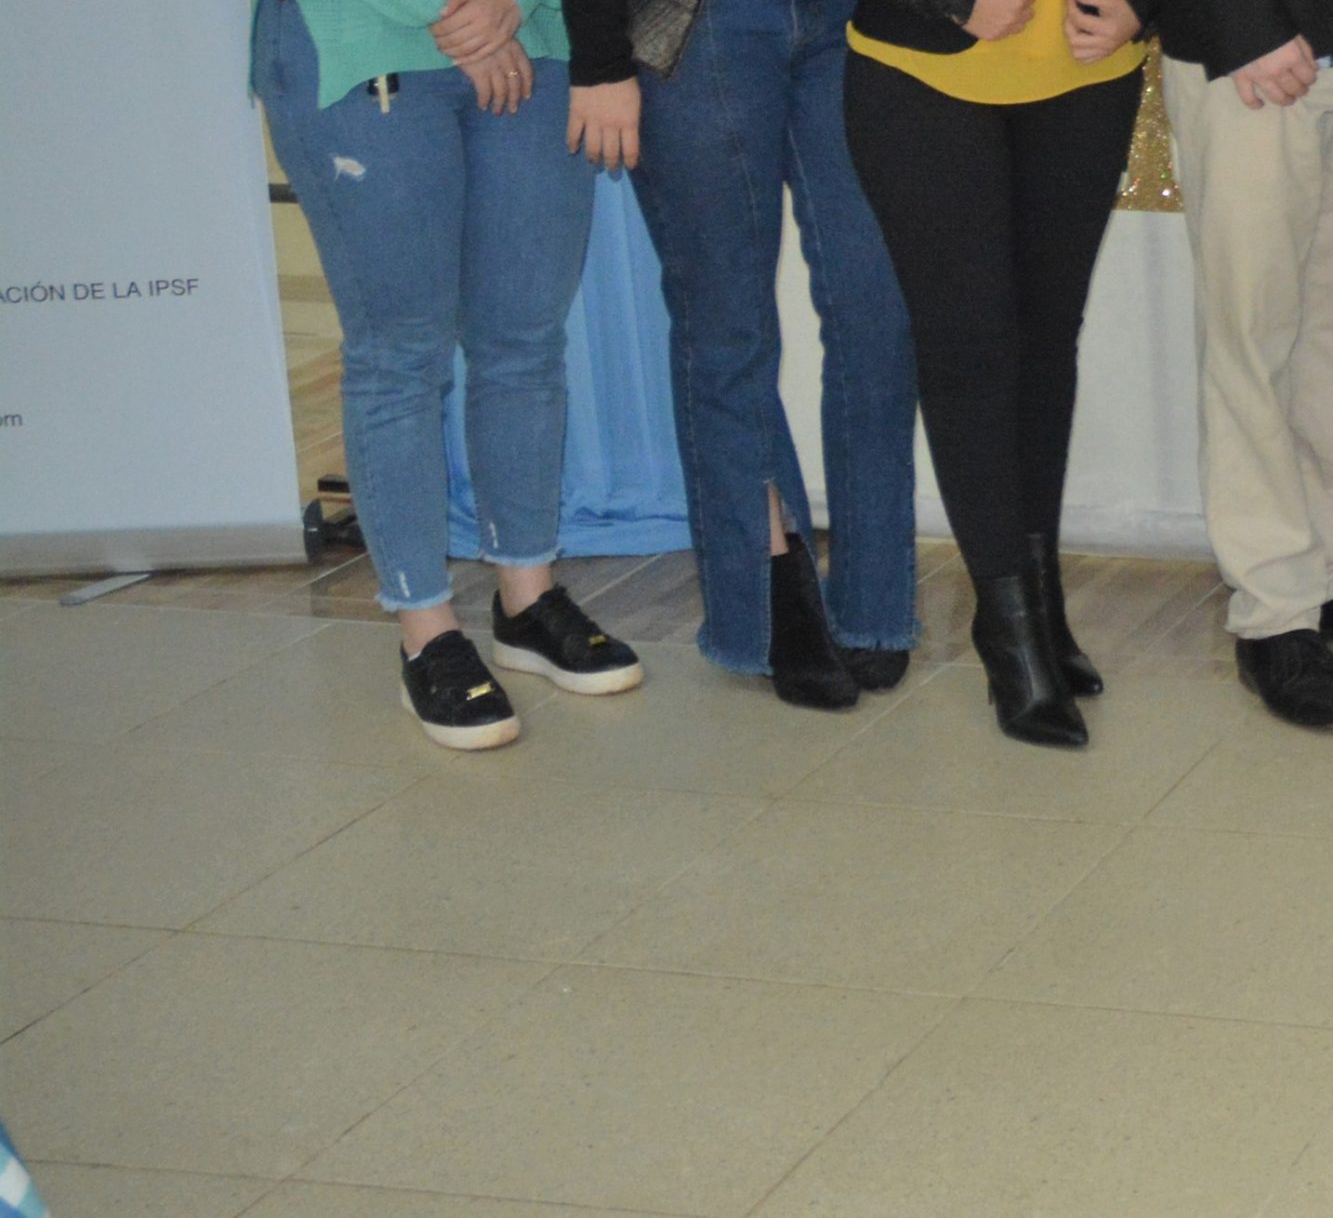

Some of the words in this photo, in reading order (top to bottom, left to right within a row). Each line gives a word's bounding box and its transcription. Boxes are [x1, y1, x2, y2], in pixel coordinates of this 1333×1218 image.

[73, 282, 105, 300] DE
[112, 281, 142, 299] LA
[148, 278, 199, 297] IPSF
